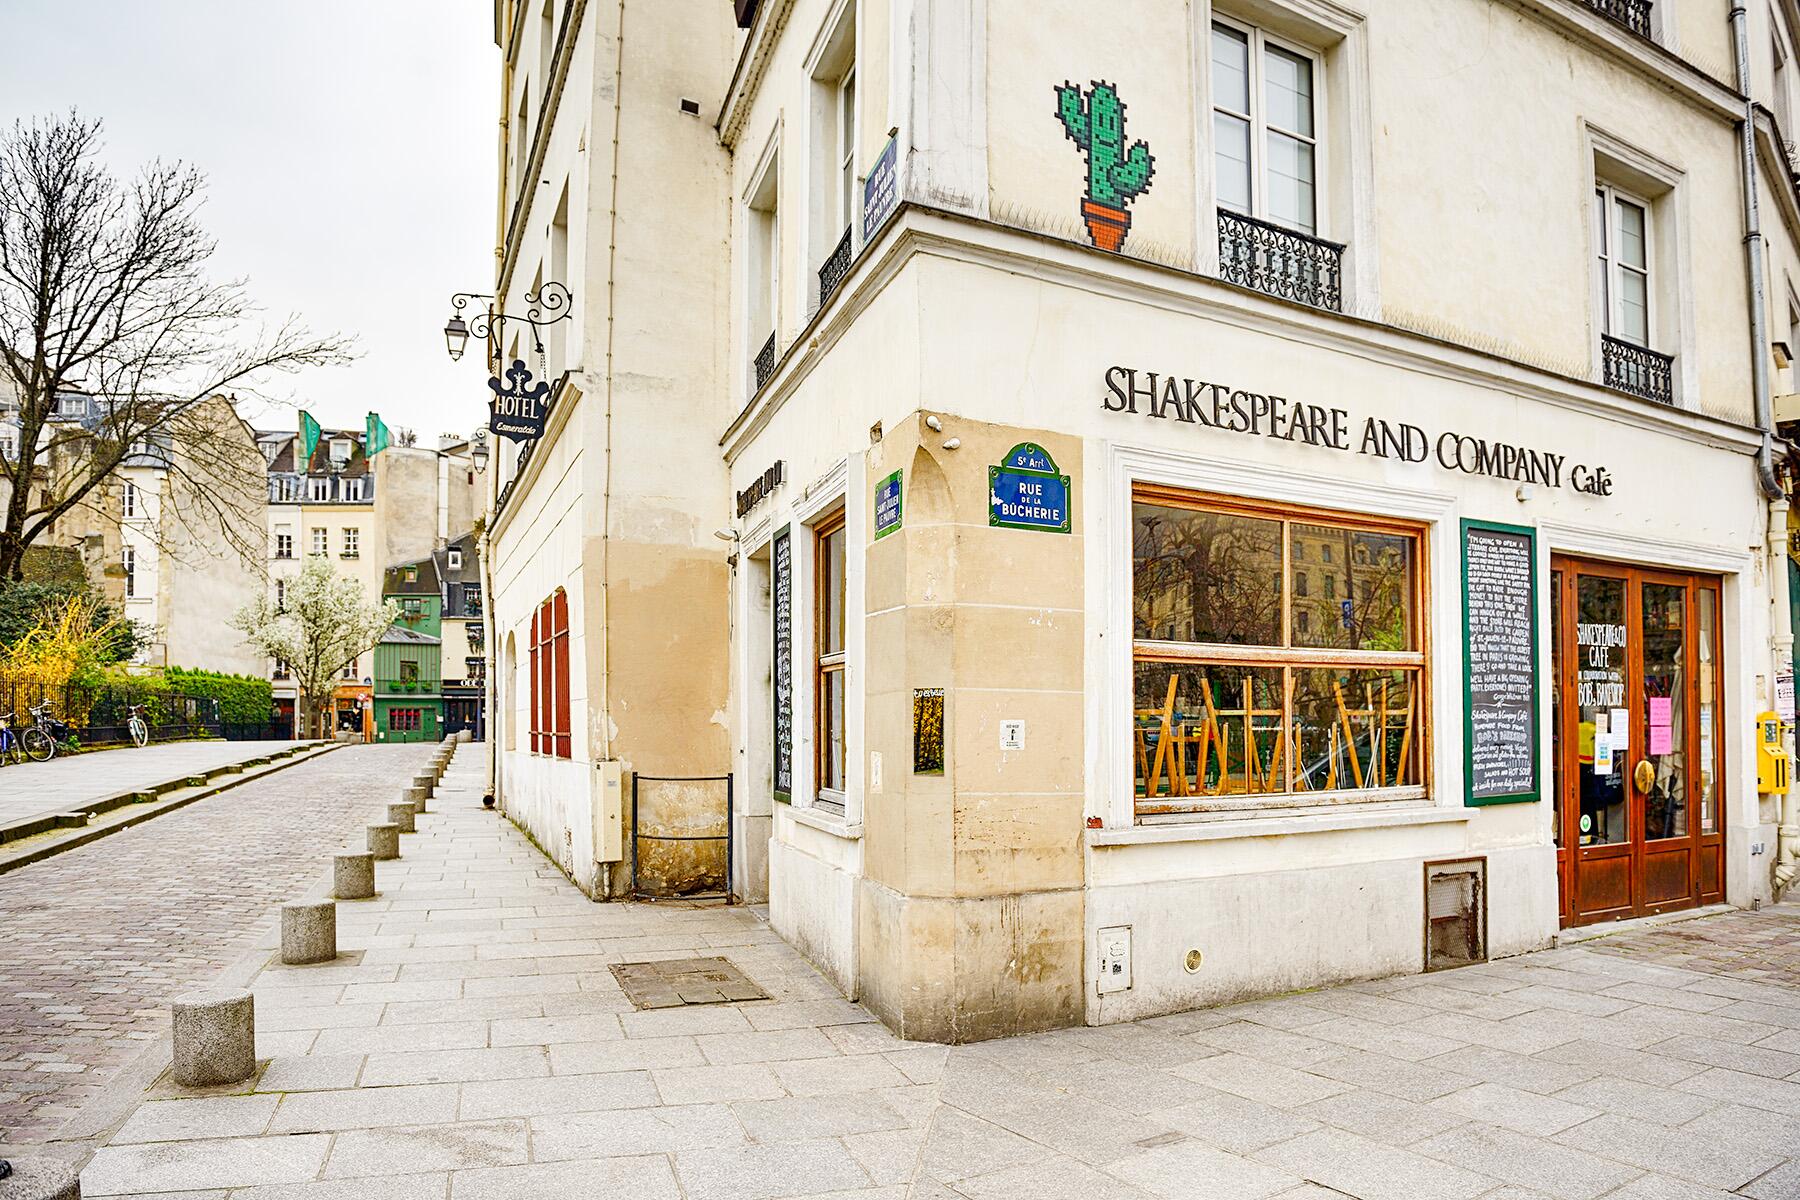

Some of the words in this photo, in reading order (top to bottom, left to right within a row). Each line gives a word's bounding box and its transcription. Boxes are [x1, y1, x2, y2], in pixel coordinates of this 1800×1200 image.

[874, 161, 886, 188] RUE
[495, 395, 539, 419] HOTEL
[496, 421, 536, 435] Esmeralda
[1103, 366, 1349, 450] SHAKESPEARE
[1360, 416, 1428, 464] AND
[1436, 431, 1566, 488] COMPANY
[1571, 464, 1612, 497] Café
[1019, 482, 1042, 497] RUE
[879, 515, 884, 526] LE
[884, 507, 896, 521] PAUVRE
[1002, 503, 1060, 521] BÛCHERIE
[1589, 646, 1609, 668] CAFE
[1477, 730, 1498, 743] BOB'S
[1508, 768, 1518, 777] HOT
